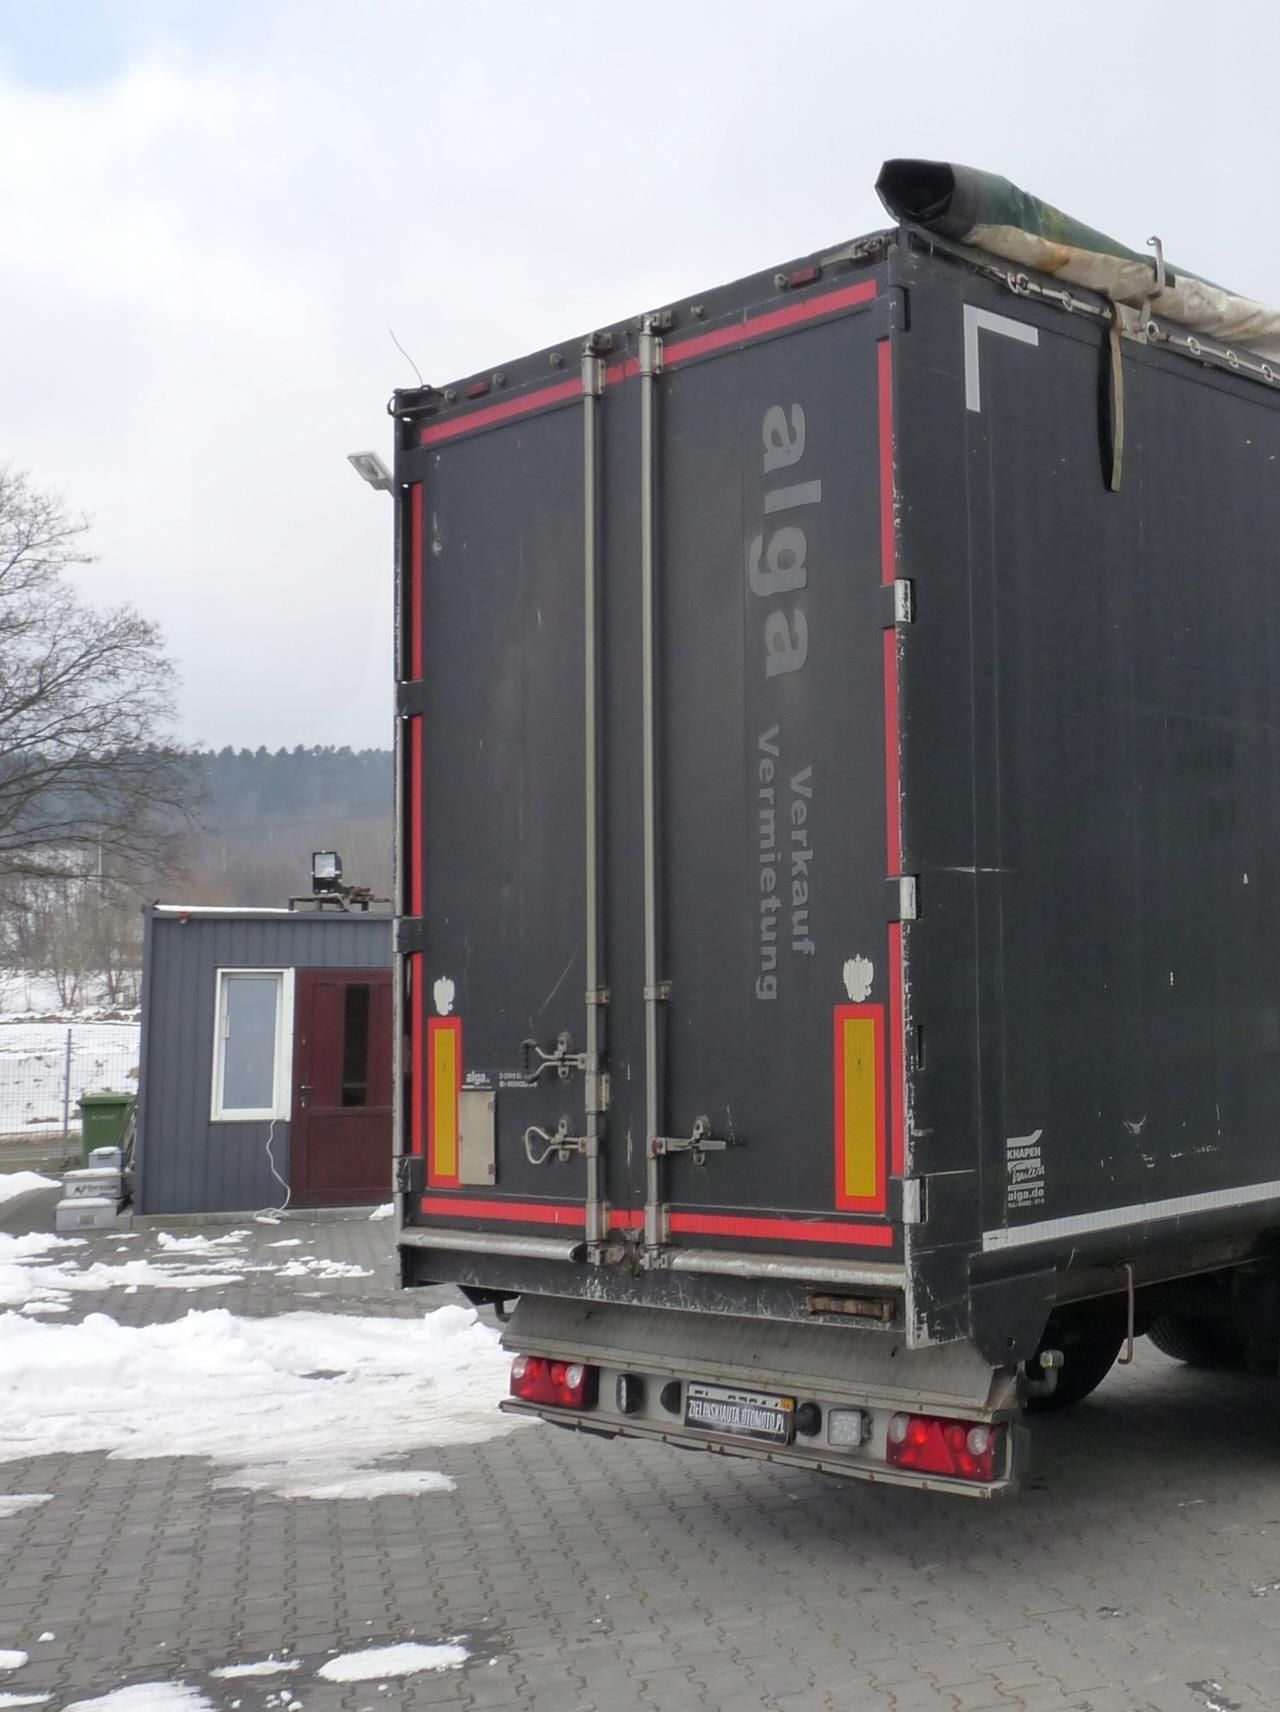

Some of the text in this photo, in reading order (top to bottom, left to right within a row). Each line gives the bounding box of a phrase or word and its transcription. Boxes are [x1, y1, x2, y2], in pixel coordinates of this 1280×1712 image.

[749, 402, 822, 680] alga
[756, 724, 780, 1001] Vermietung
[790, 765, 815, 957] Verkauf
[1007, 1146, 1041, 1160] KNAPEN
